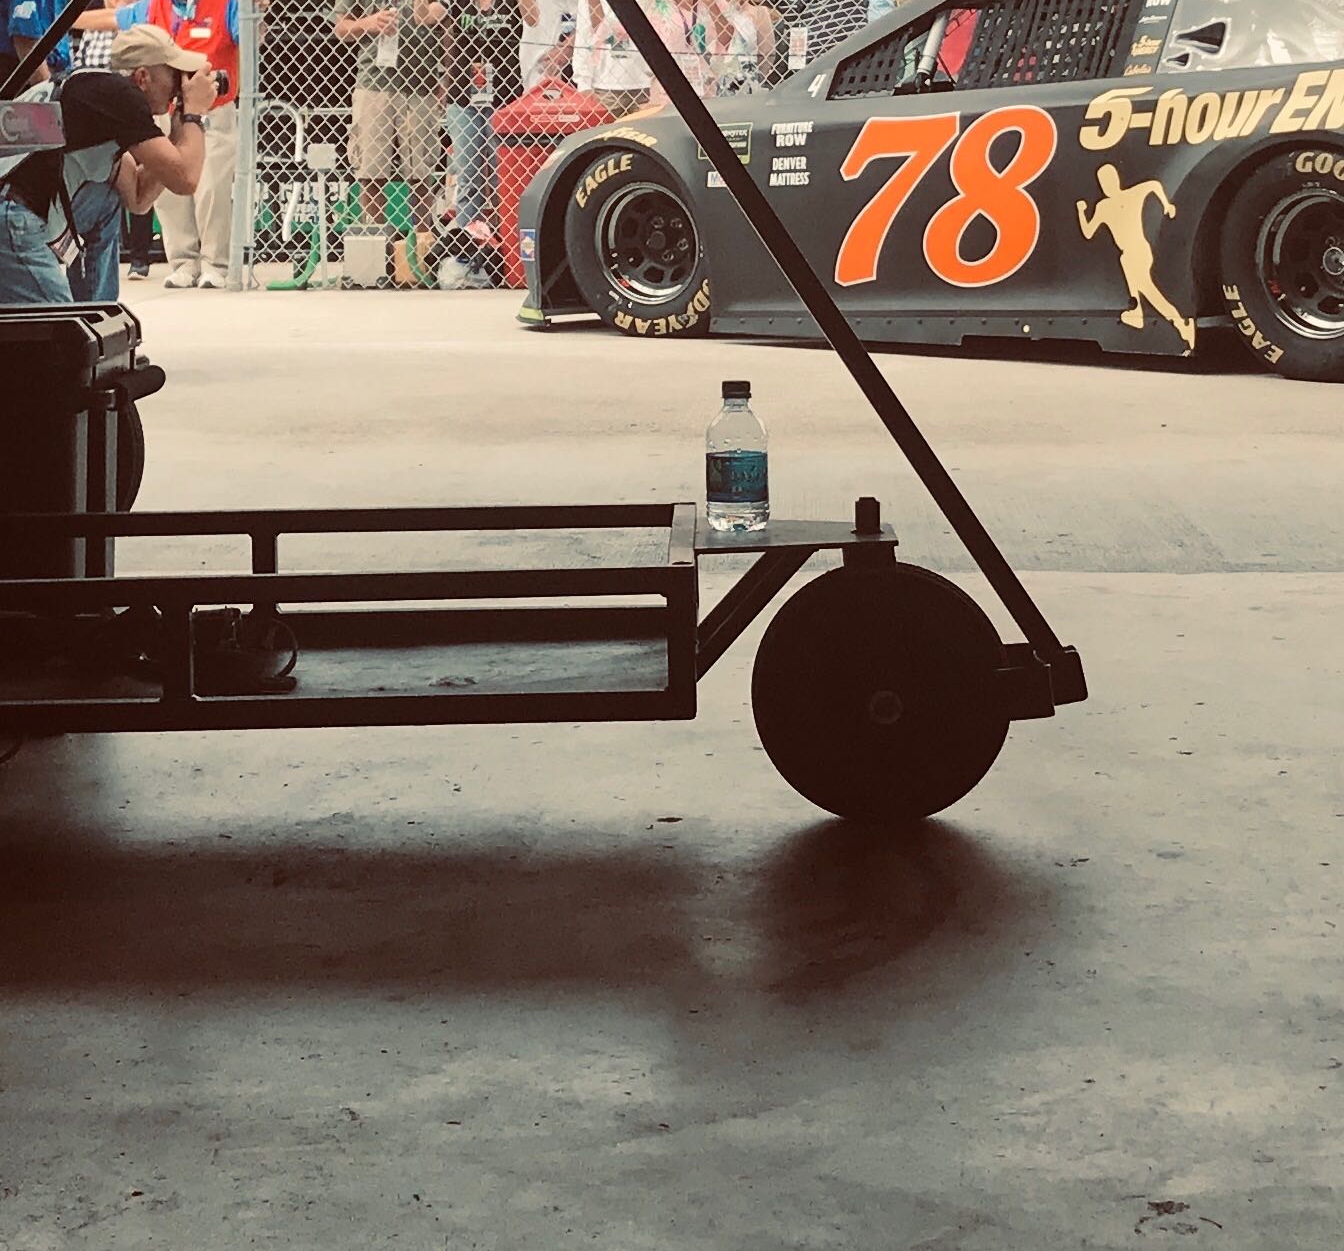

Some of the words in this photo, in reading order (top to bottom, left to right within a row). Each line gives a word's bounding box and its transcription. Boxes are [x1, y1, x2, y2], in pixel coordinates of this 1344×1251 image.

[771, 121, 814, 135] FURNITURE
[1078, 85, 1286, 151] 5-hour
[775, 133, 808, 147] ROW
[575, 153, 634, 208] EAGLE
[769, 172, 811, 186] MATTRESS
[772, 156, 808, 171] DENVER
[834, 104, 1059, 288] 78
[1222, 284, 1285, 364] EAGLE
